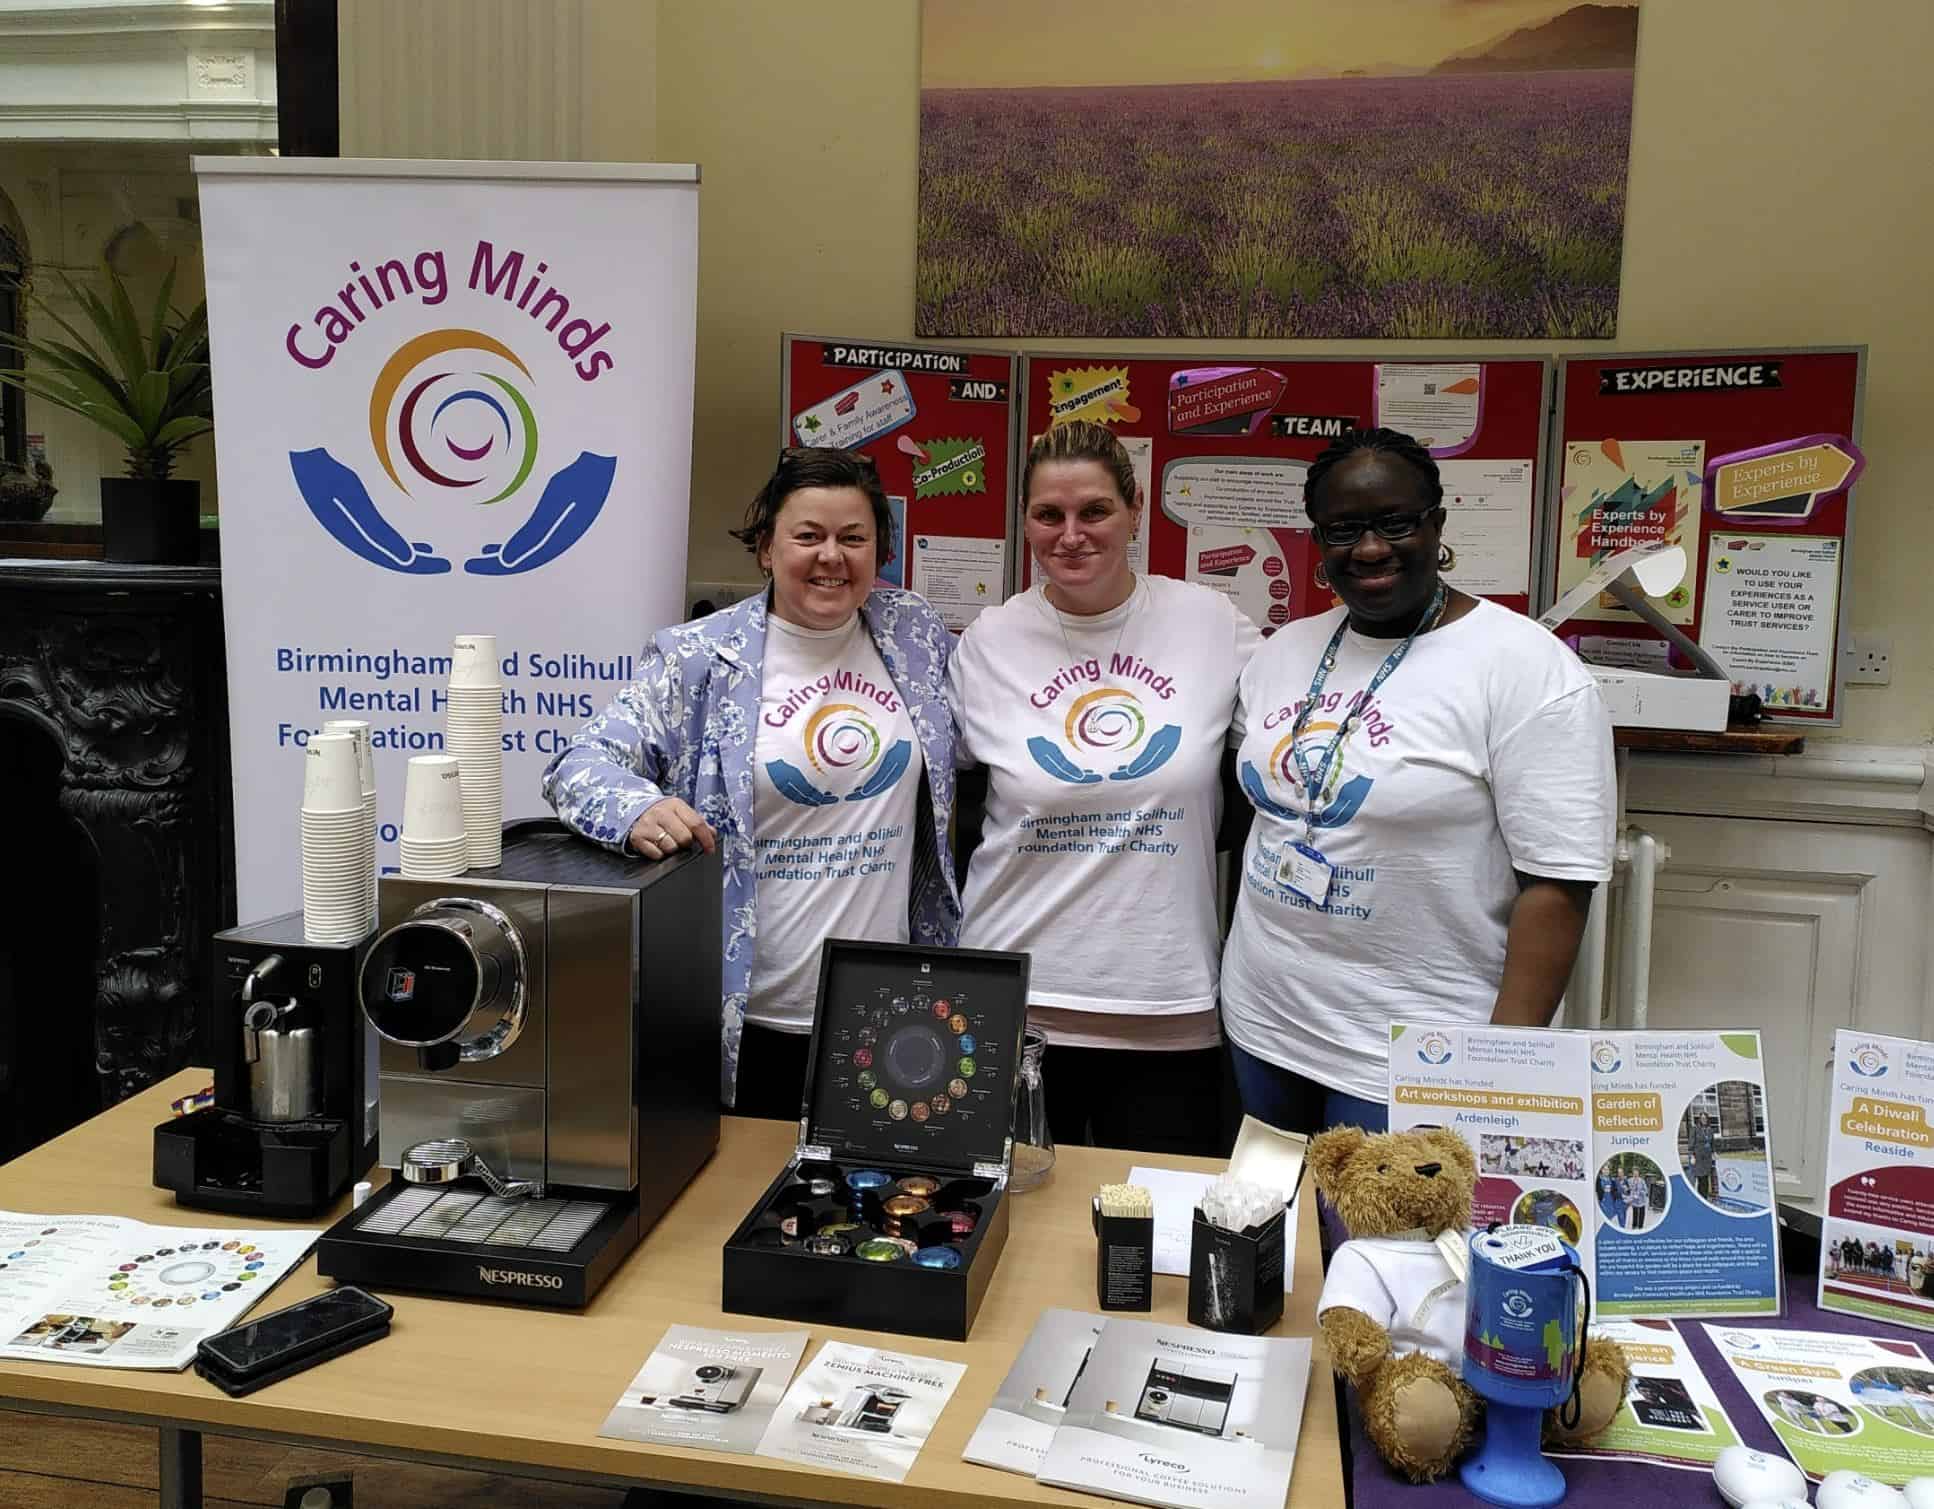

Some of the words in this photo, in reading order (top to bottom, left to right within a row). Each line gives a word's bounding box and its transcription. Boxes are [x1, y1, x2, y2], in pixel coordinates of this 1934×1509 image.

[286, 249, 448, 369] Caring
[468, 240, 614, 382] Minds
[833, 347, 960, 371] PARTICIPATION
[1616, 366, 1763, 390] EXPERIENCE
[962, 383, 996, 399] AND
[1055, 378, 1124, 413] Engagement
[1176, 377, 1257, 408] Participation
[1176, 406, 1201, 422] and
[1204, 389, 1272, 416] Experience
[1284, 417, 1341, 437] TEAM
[915, 447, 985, 486] Co-Production
[1732, 461, 1794, 483] Experts
[1799, 455, 1818, 471] by
[1732, 473, 1822, 499] Experience
[1592, 509, 1645, 524] Experts
[1650, 509, 1666, 523] by
[1591, 522, 1665, 535] Experience
[1737, 568, 1769, 577] WOULD
[1772, 570, 1790, 578] YOU
[1792, 571, 1812, 579] LIKE
[1744, 579, 1756, 588] TO
[1758, 580, 1776, 589] USE
[1778, 581, 1803, 590] YOUR
[1730, 590, 1791, 601] EXPERIENCES
[1793, 593, 1806, 601] AS
[1732, 600, 1769, 609] SERVICE
[1771, 602, 1795, 610] USER
[1798, 603, 1811, 611] OR
[1727, 609, 1757, 618] CARER
[1760, 611, 1772, 619] TO
[1773, 612, 1815, 621] IMPROVE
[1730, 619, 1758, 628] TRUST
[1760, 622, 1810, 632] SERVICES?
[277, 648, 452, 679] Birmingham
[529, 654, 633, 681] Solihull
[1376, 663, 1393, 683] NHS
[1030, 659, 1101, 709] Caring
[1109, 652, 1177, 700] Minds
[319, 686, 420, 712] Mental
[432, 689, 526, 717] Hth
[537, 693, 593, 718] NHS
[765, 676, 831, 728] Caring
[834, 668, 901, 713] Minds
[1264, 691, 1343, 730] Carng
[279, 724, 443, 750] Foation
[1105, 809, 1132, 823] and
[1135, 807, 1185, 822] Solihull
[1036, 825, 1084, 840] Mental
[1088, 824, 1131, 839] Health
[1134, 823, 1163, 837] NHS
[755, 834, 832, 850] irmingham
[837, 832, 862, 846] and
[1099, 841, 1127, 855] Trust
[1129, 839, 1179, 857] Charity
[765, 851, 814, 866] Mental
[755, 866, 821, 882] undation
[826, 865, 855, 880] Trust
[1331, 865, 1375, 882] lihull
[1330, 884, 1350, 898] HS
[1279, 890, 1311, 911] Trust
[1510, 1057, 1528, 1065] Trust
[1395, 1074, 1420, 1085] Caring
[1423, 1075, 1447, 1085] Minds
[1449, 1077, 1463, 1086] has
[1635, 1081, 1648, 1090] has
[1400, 1089, 1418, 1099] Art
[1422, 1090, 1488, 1105] workshops
[1491, 1095, 1514, 1105] and
[1518, 1098, 1578, 1111] exhibition
[1840, 1082, 1869, 1096] Caring
[1871, 1088, 1899, 1099] Minds
[1900, 1091, 1916, 1102] has
[1596, 1098, 1640, 1110] Garden
[1644, 1098, 1656, 1109] of
[1858, 1103, 1869, 1113] A
[1873, 1104, 1920, 1121] Diwali
[1455, 1112, 1520, 1128] Ardenleigh
[1597, 1115, 1658, 1128] Reflection
[1847, 1119, 1929, 1143] Celebration
[1610, 1135, 1650, 1148] Juniper
[1865, 1141, 1915, 1158] Reaside
[1499, 1249, 1535, 1265] THANK
[1535, 1241, 1556, 1255] YOU
[475, 1264, 563, 1290] NESPRESSO
[823, 1360, 862, 1373] ZENIUS
[864, 1368, 917, 1383] MACHINE
[1080, 1456, 1150, 1478] PROFESSIONAL
[1144, 1454, 1186, 1471] Lyreco
[1113, 1469, 1132, 1478] FOR
[1135, 1474, 1161, 1485] YOUR
